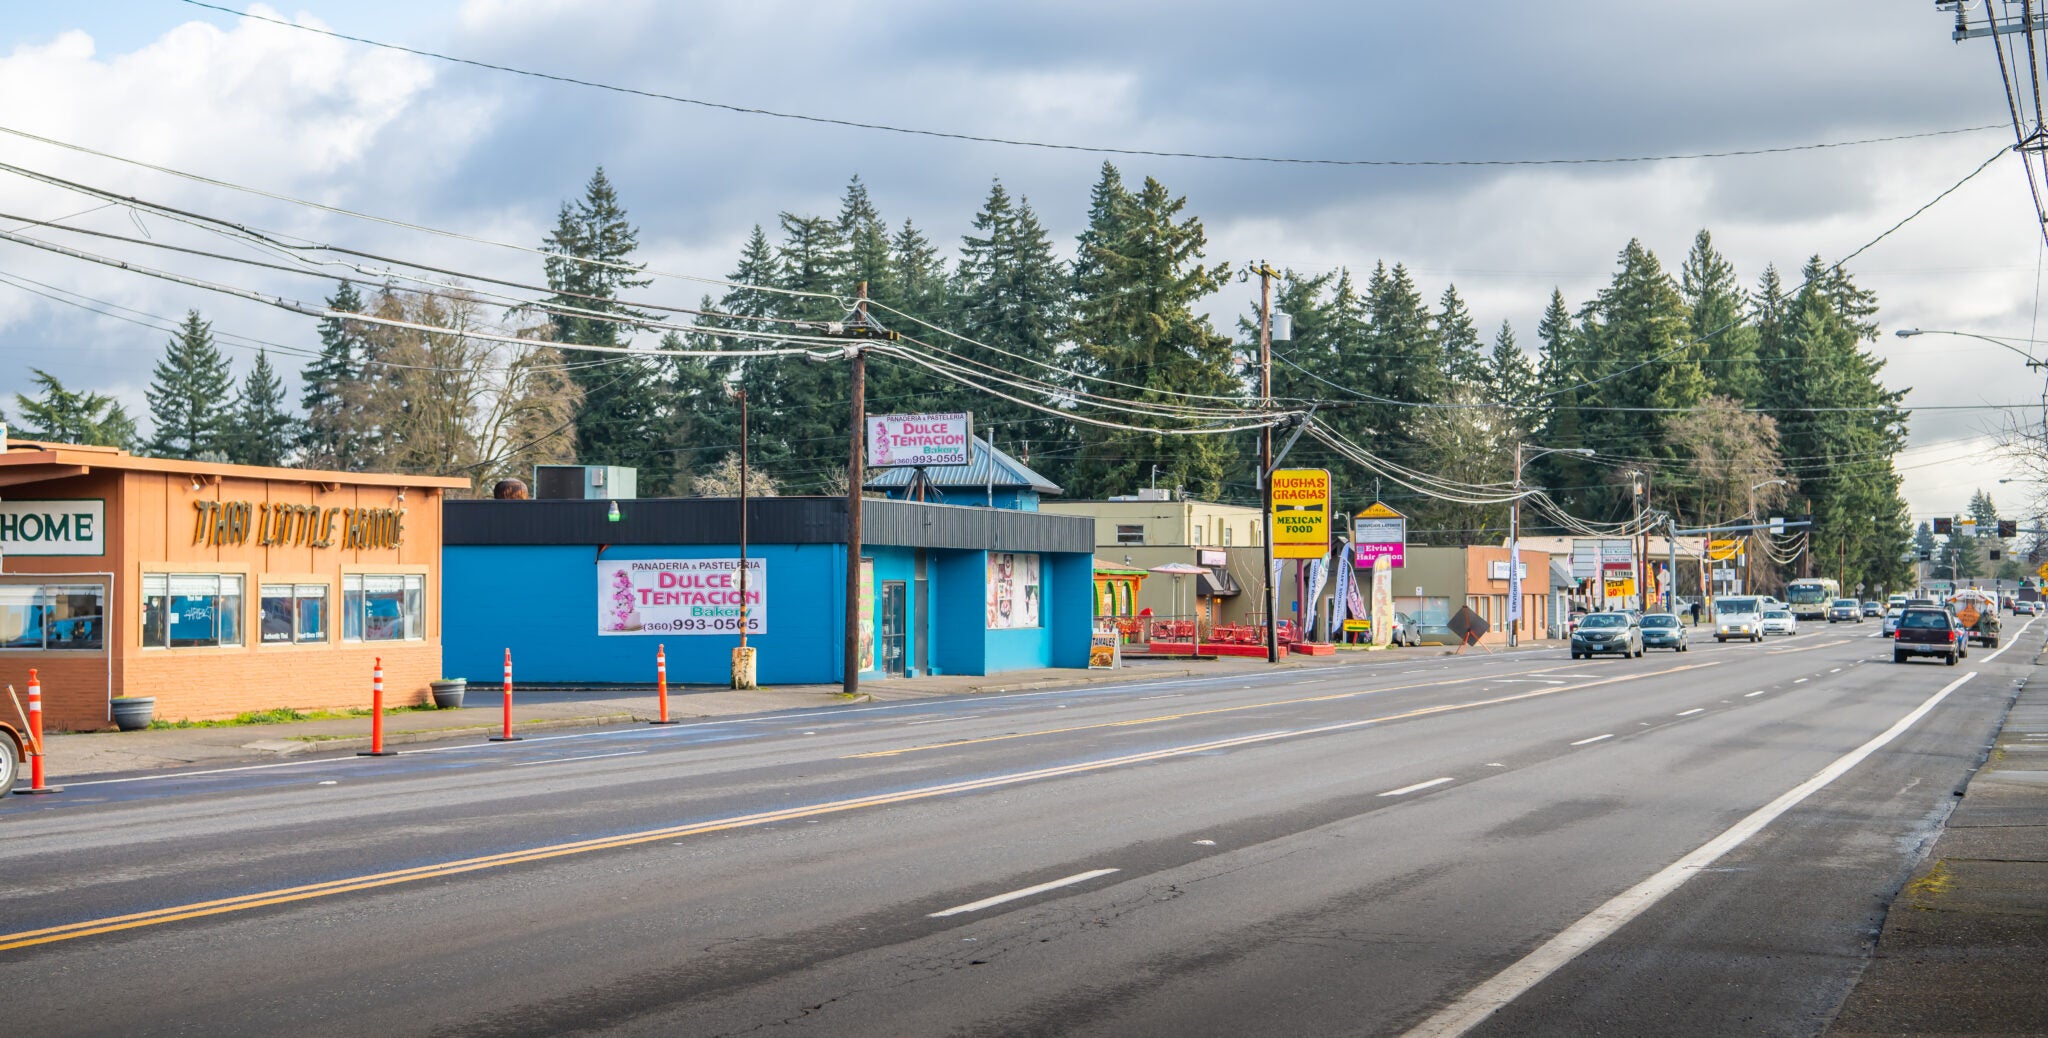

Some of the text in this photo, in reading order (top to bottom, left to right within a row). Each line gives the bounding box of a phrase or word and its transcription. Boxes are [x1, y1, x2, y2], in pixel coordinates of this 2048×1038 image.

[902, 422, 948, 435] DULCE
[890, 434, 964, 447] TENTACION
[923, 446, 960, 454] Bakery
[0, 513, 94, 542] HOME
[632, 562, 690, 570] PANADERIA
[658, 572, 732, 589] DULCE
[637, 588, 760, 606] TENTACION
[1092, 637, 1116, 647] TAMALES
